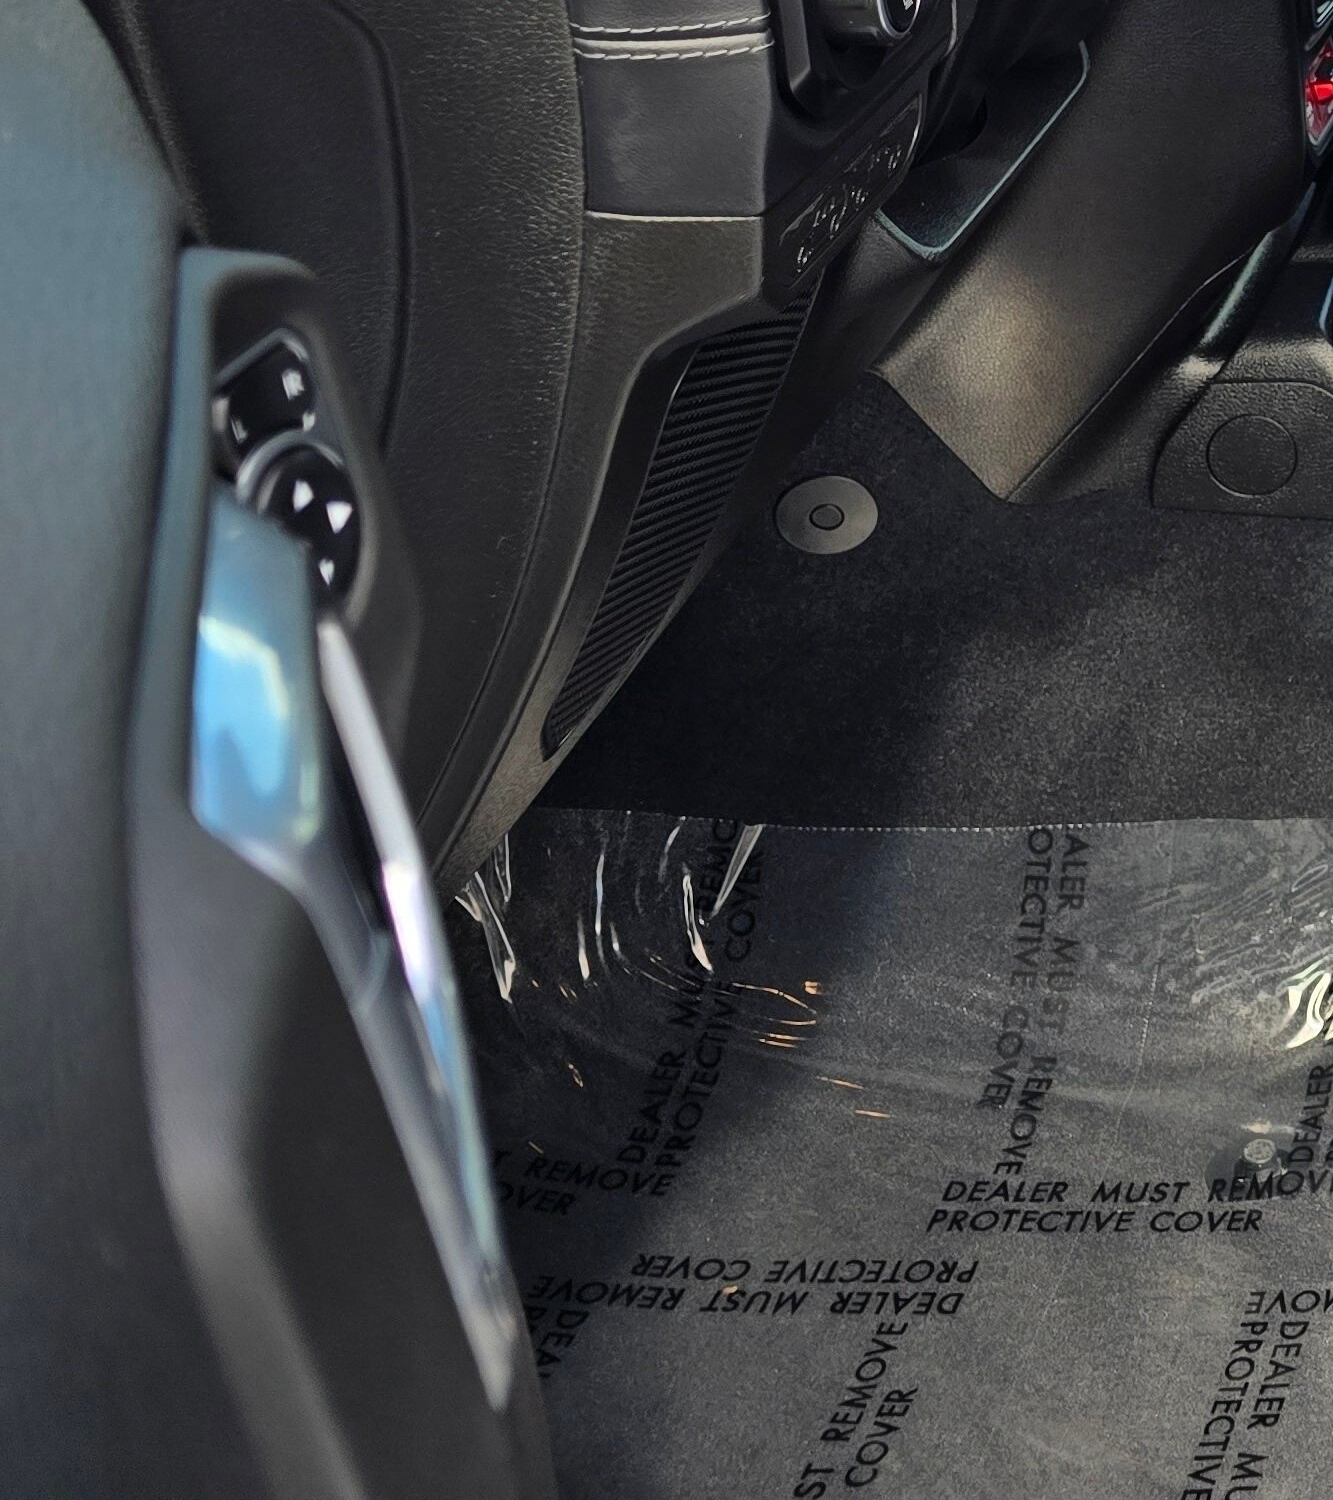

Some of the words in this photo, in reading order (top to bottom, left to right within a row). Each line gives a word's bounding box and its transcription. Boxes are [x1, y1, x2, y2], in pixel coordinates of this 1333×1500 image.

[523, 1156, 676, 1197] REMOVE
[942, 1181, 1069, 1203] DEALER
[1090, 1181, 1190, 1204] MUST
[926, 1209, 1136, 1233] PROTECTIVE
[1150, 1209, 1264, 1233] COVER
[631, 1253, 750, 1281] COVER
[764, 1259, 979, 1284] PROTECTIVE
[527, 1275, 685, 1311] REMOVE
[700, 1290, 809, 1316] MUST
[830, 1291, 965, 1315] DEALER
[820, 1322, 909, 1442] REMOVE
[1247, 1321, 1310, 1430] DEALER
[1181, 1321, 1269, 1500] PROTECTIVE
[845, 1387, 919, 1487] COVER
